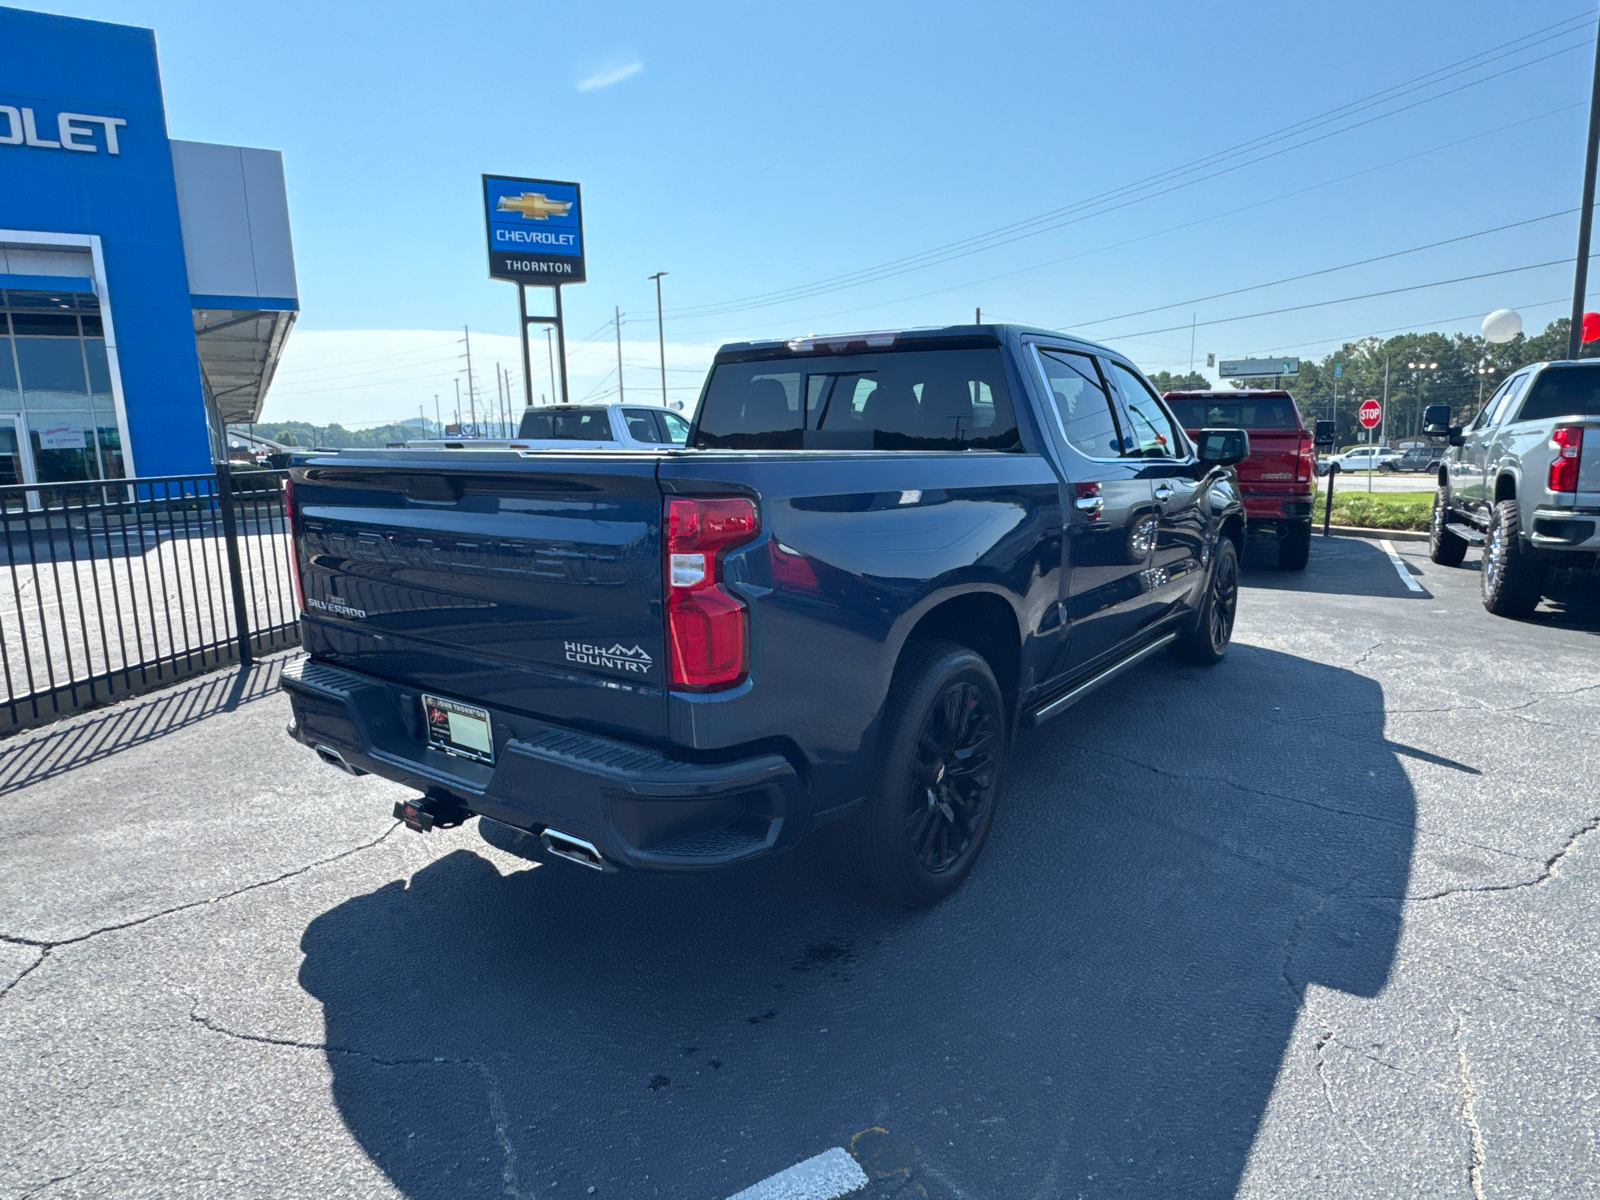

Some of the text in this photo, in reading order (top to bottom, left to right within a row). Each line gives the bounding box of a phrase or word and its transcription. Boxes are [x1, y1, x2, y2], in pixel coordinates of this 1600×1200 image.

[496, 229, 575, 246] CHEVROLET
[505, 260, 572, 273] THORNTON
[1361, 408, 1380, 420] STOP
[307, 598, 366, 618] SILVERADO
[564, 641, 606, 655] HIGH
[565, 651, 652, 673] COUNTRY
[437, 700, 453, 710] JOHN
[453, 704, 486, 718] THORNTON
